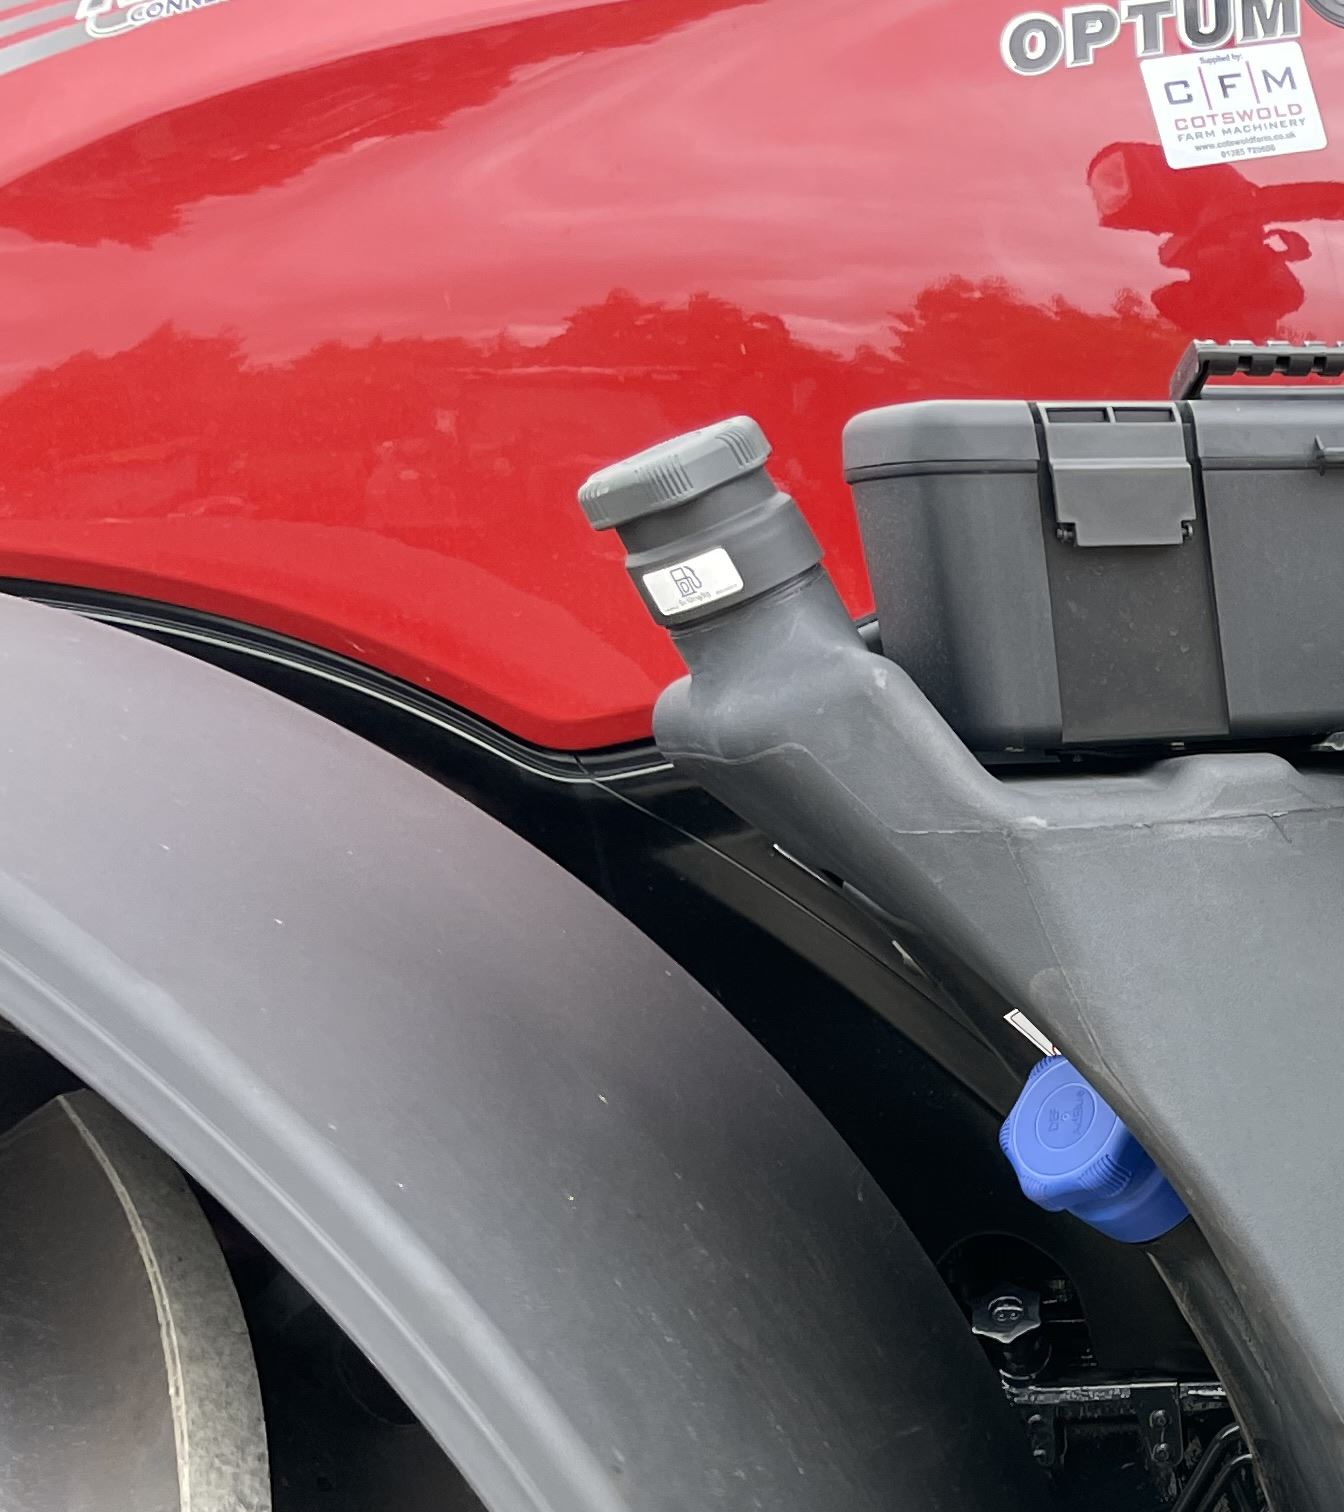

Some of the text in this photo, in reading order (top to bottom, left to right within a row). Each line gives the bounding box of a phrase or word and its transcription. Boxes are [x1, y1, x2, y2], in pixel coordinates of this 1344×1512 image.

[1000, 0, 1300, 76] OPTUM
[1174, 103, 1303, 131] COTSWOLD
[1177, 117, 1307, 143] FARM MACHINERY
